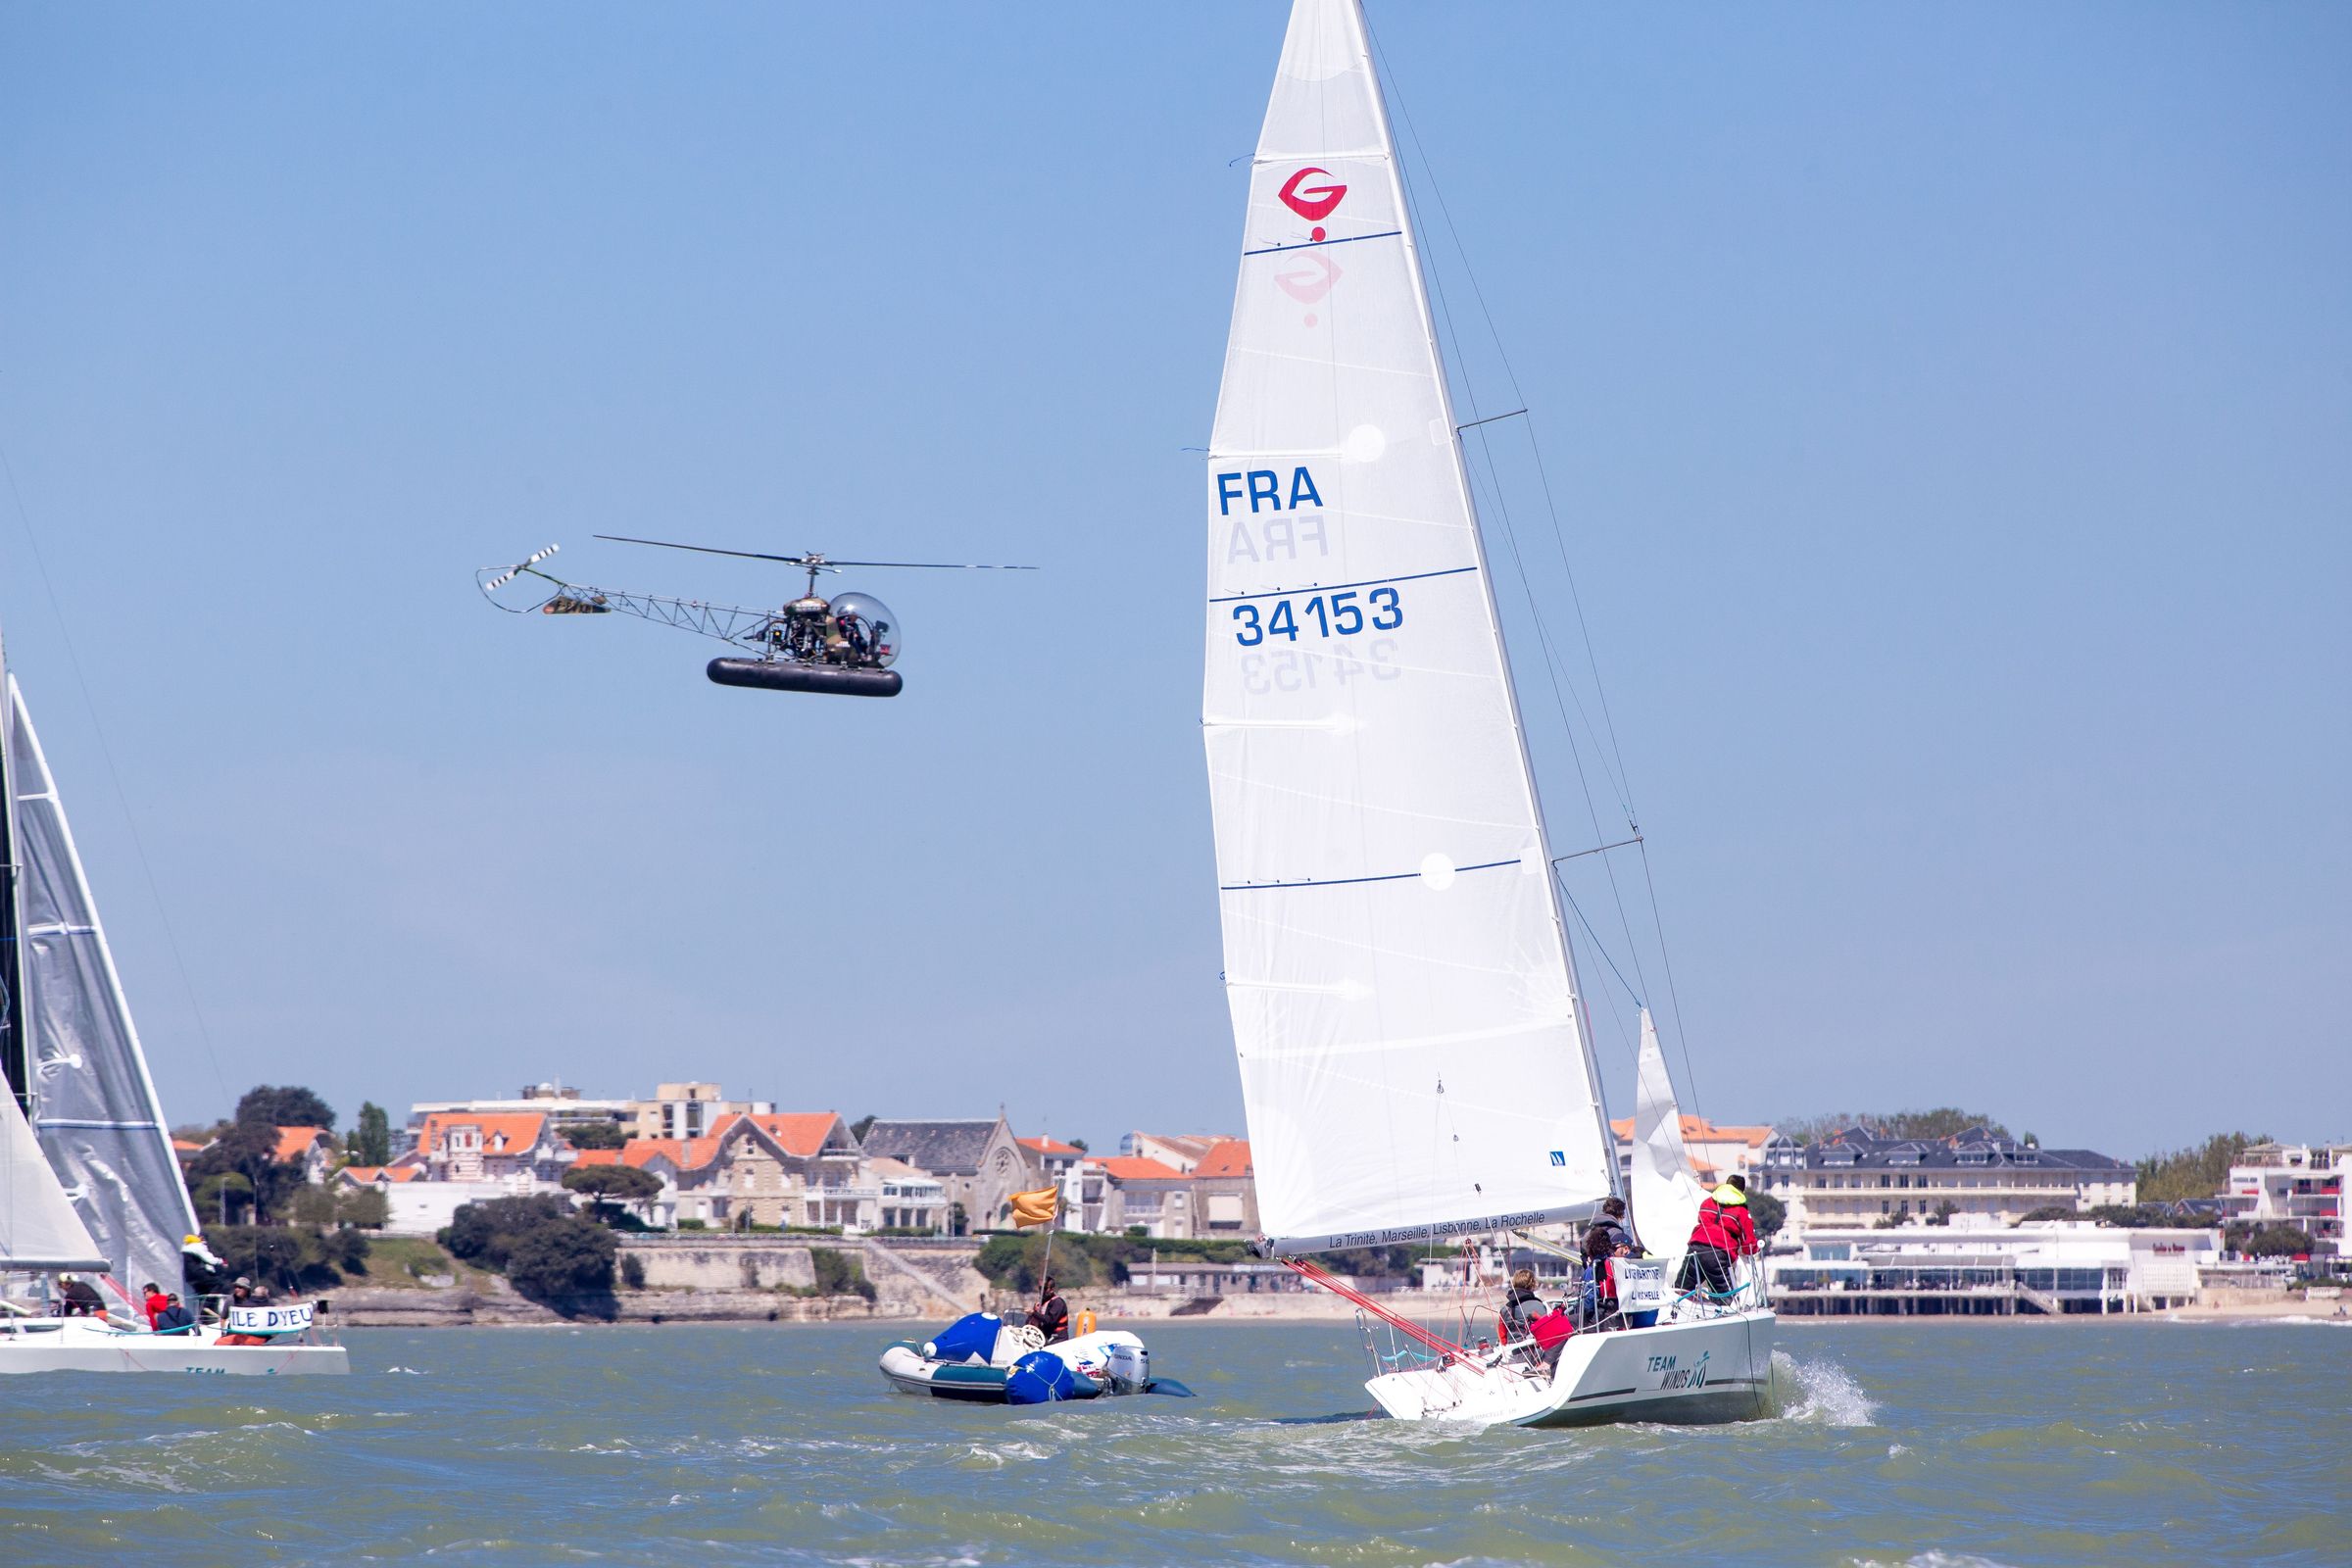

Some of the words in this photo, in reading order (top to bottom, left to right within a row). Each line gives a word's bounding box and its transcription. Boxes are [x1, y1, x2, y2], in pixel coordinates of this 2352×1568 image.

[1217, 466, 1324, 515] FRA
[1232, 587, 1403, 647] 34153
[1329, 1236, 1343, 1249] La
[1381, 1226, 1430, 1243] Marseille,
[1433, 1219, 1482, 1235] Lisbonne,
[1485, 1216, 1497, 1229] La
[1500, 1211, 1545, 1227] Rochelle
[232, 1310, 259, 1328] ILE
[1646, 1355, 1677, 1373] TEAM
[1659, 1368, 1690, 1391] WINDS
